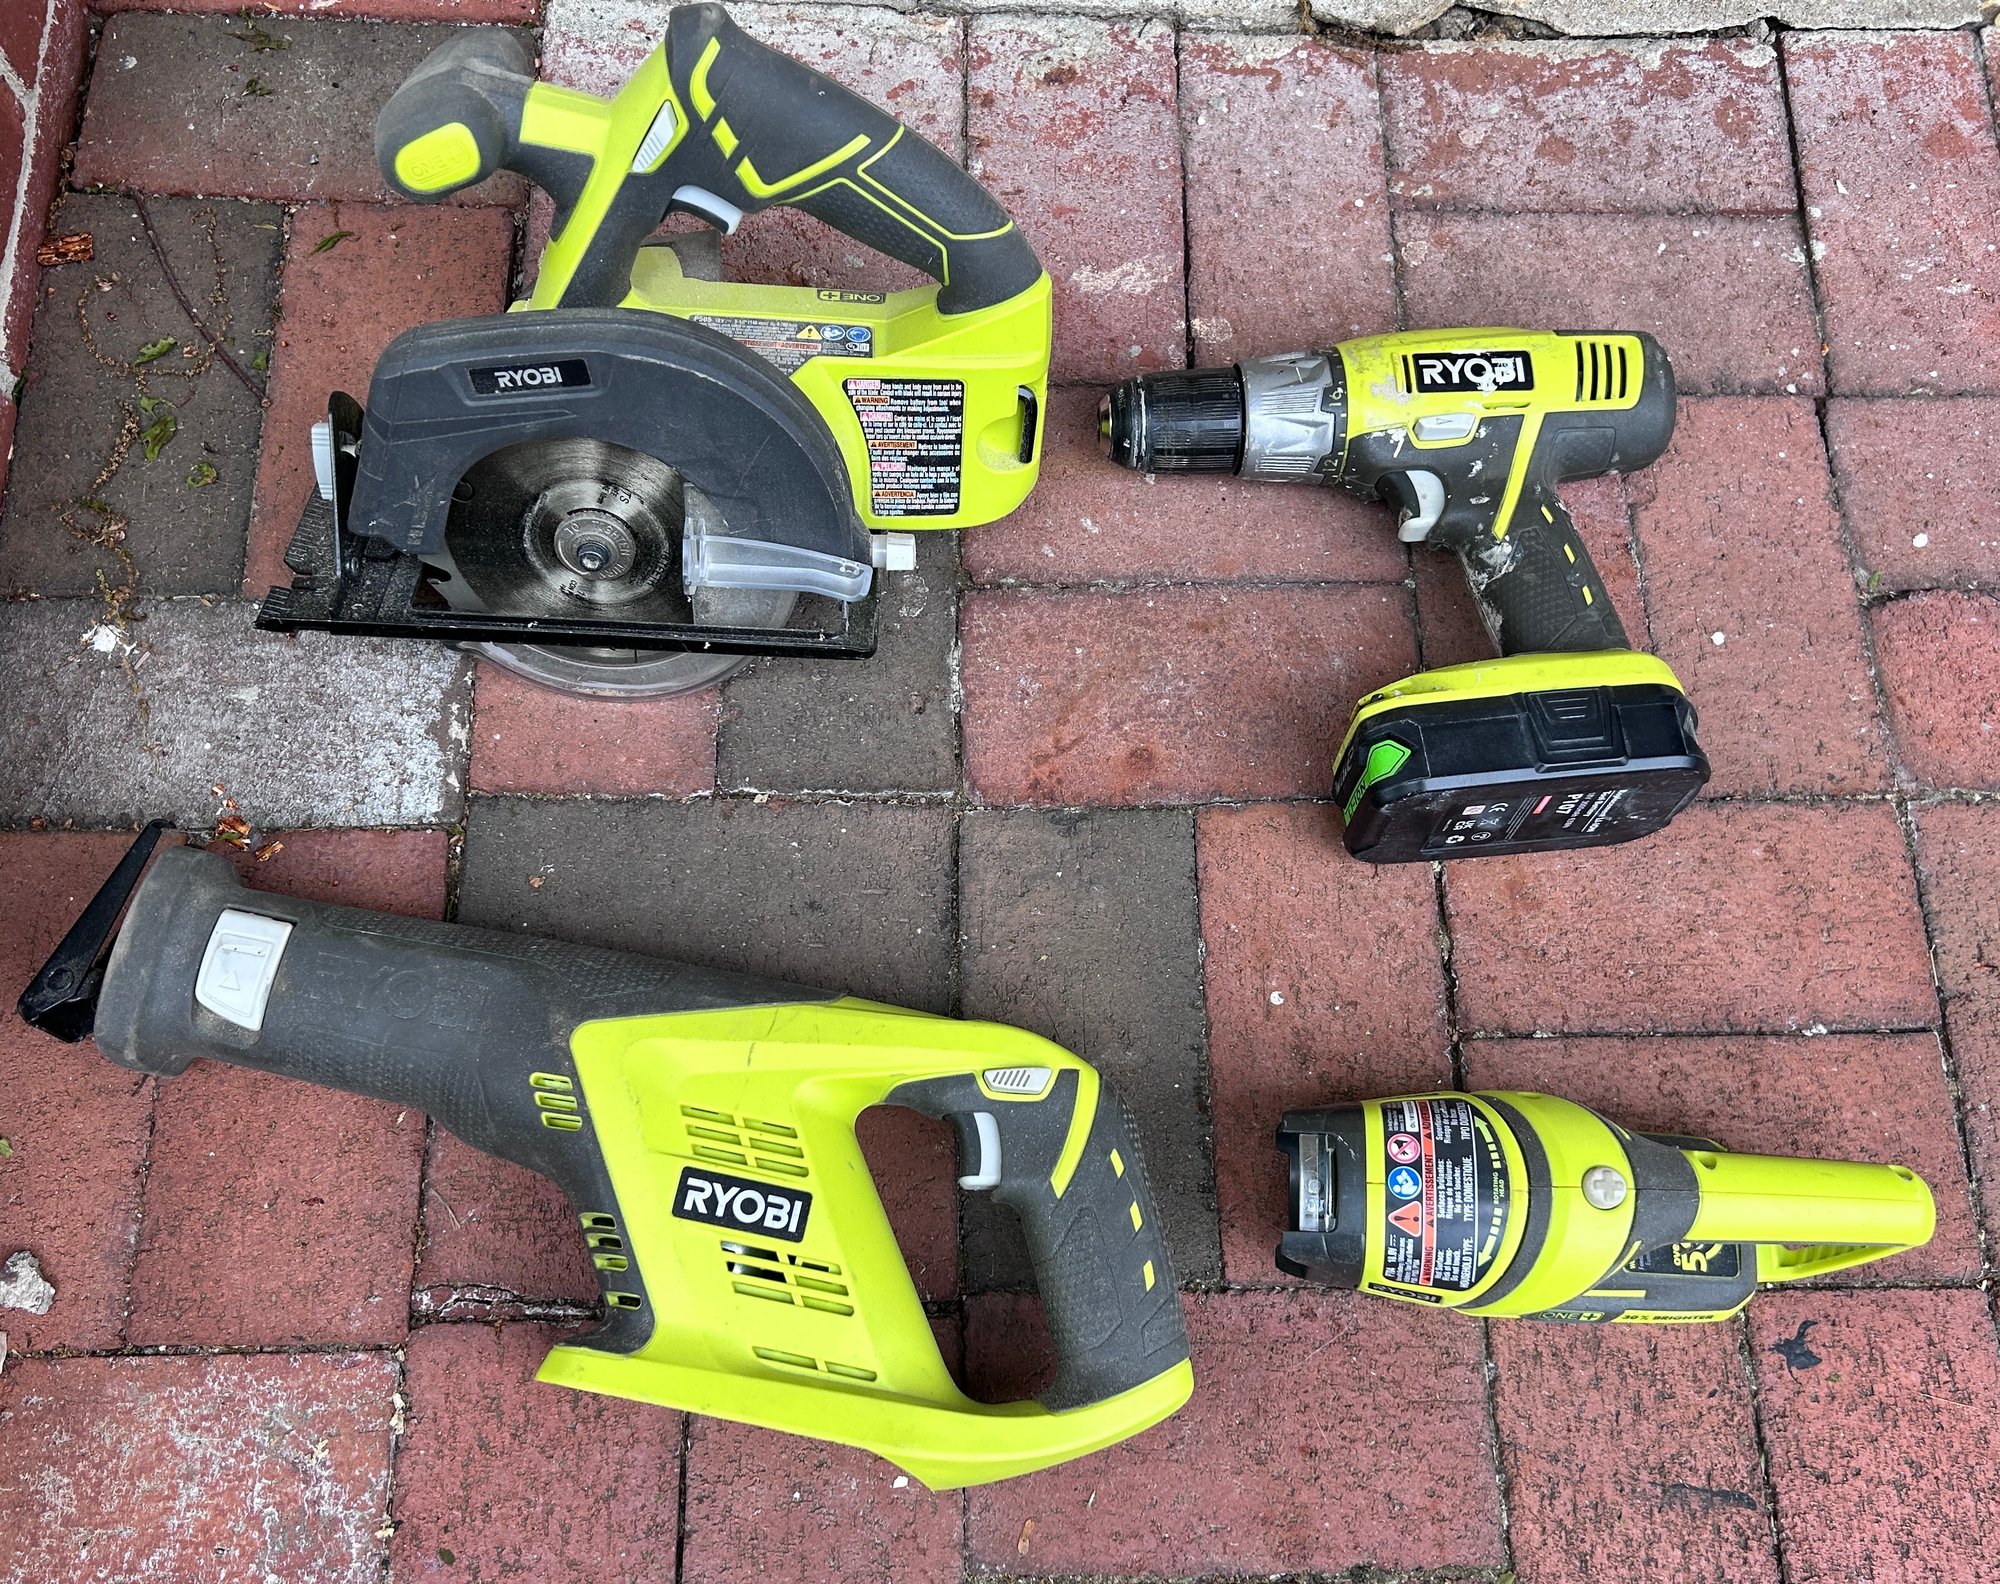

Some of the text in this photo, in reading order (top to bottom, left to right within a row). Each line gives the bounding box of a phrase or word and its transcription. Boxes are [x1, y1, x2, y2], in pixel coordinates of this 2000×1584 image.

[494, 366, 563, 388] RYOBI
[1418, 357, 1526, 385] RYOBI
[1555, 793, 1584, 815] P107
[1460, 1127, 1470, 1140] TIPO
[1424, 1153, 1434, 1216] AVERTISSEMENT
[1445, 1187, 1453, 1196] de
[1453, 1165, 1462, 1213] Ne pas toucher.
[1462, 1155, 1474, 1222] TYPE DOMESTIQUE.
[1492, 1172, 1500, 1205] ROTATING
[683, 1177, 803, 1233] RYOBI
[1437, 1191, 1446, 1218] Surfaces
[1445, 1197, 1454, 1219] Risque
[1422, 1246, 1434, 1276] WARNING
[1460, 1237, 1473, 1288] HOUSEHOLD TYPE.
[1672, 1243, 1680, 1266] ove
[1681, 1243, 1708, 1272] 5
[1373, 1285, 1437, 1302] RYOBI
